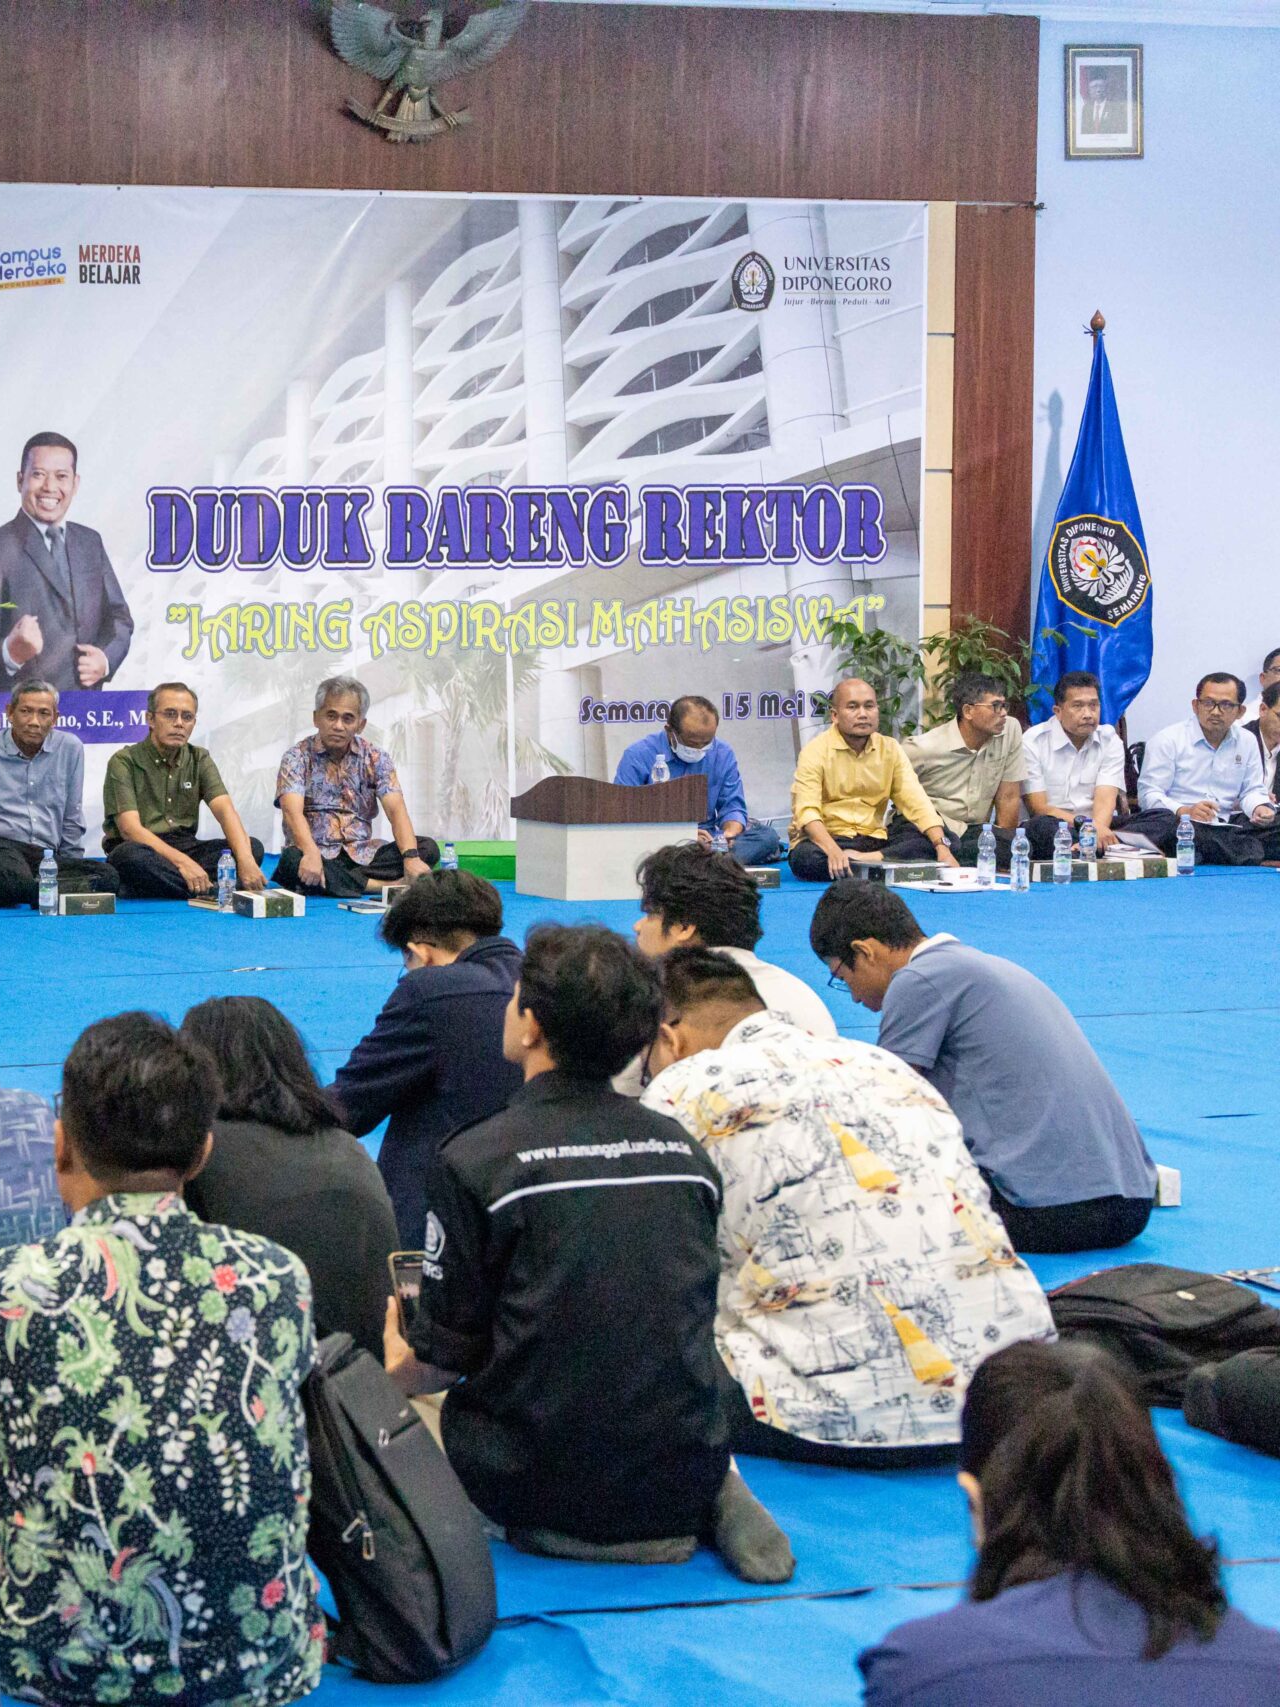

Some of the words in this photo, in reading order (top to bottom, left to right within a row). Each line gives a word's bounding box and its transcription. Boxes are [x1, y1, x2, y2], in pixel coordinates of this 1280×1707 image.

[78, 245, 141, 263] MERDEKA
[784, 256, 891, 272] UNIVERSITAS
[78, 264, 141, 285] BELAJAR
[783, 276, 892, 292] DIPONEGORO
[148, 487, 375, 572] DUDUK
[384, 485, 629, 569] BARENG
[640, 485, 887, 565] REKTOR
[1058, 537, 1070, 592] UNIVERSITAS
[1107, 574, 1147, 619] SEMARANG
[362, 599, 579, 659] ASPIRASI
[86, 710, 124, 729] S.E.,
[580, 697, 673, 723] Semara
[722, 692, 751, 720] 15
[758, 690, 805, 718] Mei
